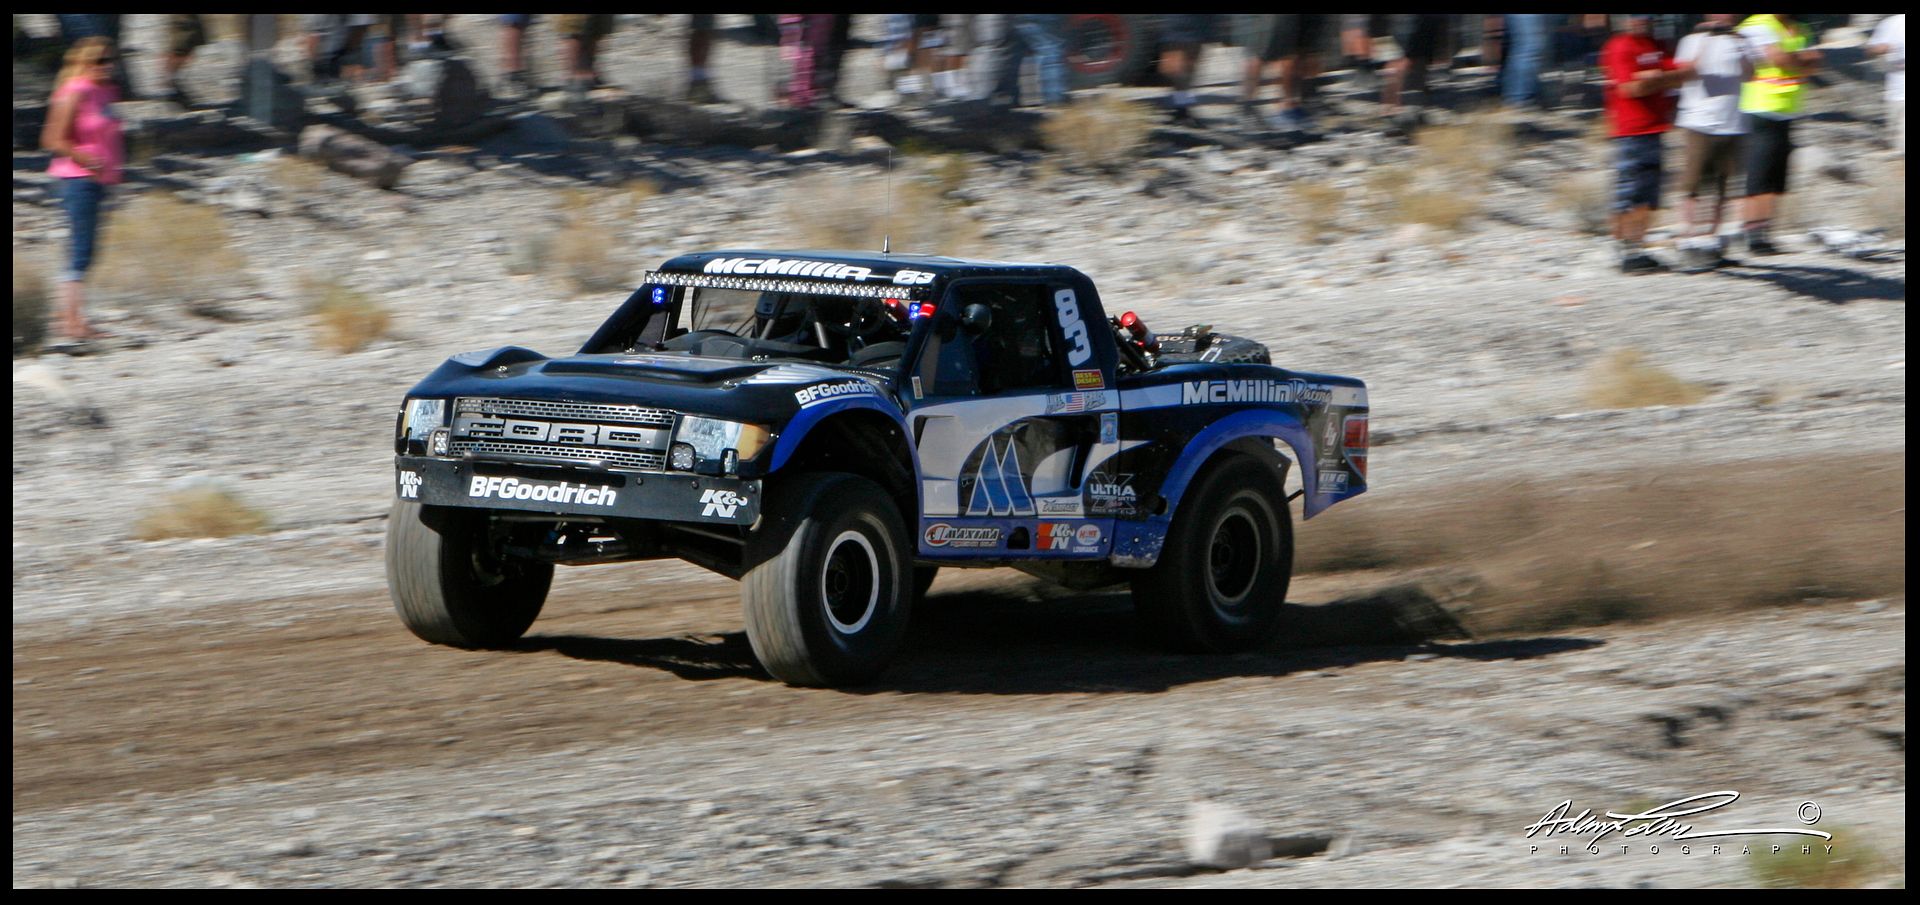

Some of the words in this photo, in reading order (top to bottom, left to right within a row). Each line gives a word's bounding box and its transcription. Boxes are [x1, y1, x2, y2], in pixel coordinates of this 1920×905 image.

[892, 269, 936, 285] 83
[1054, 288, 1092, 367] 83
[794, 380, 877, 405] BFGoodrich
[1183, 379, 1292, 405] McMillin
[452, 416, 669, 450] FORD
[468, 476, 617, 506] BFGoodrich
[1090, 483, 1136, 496] ULTRA
